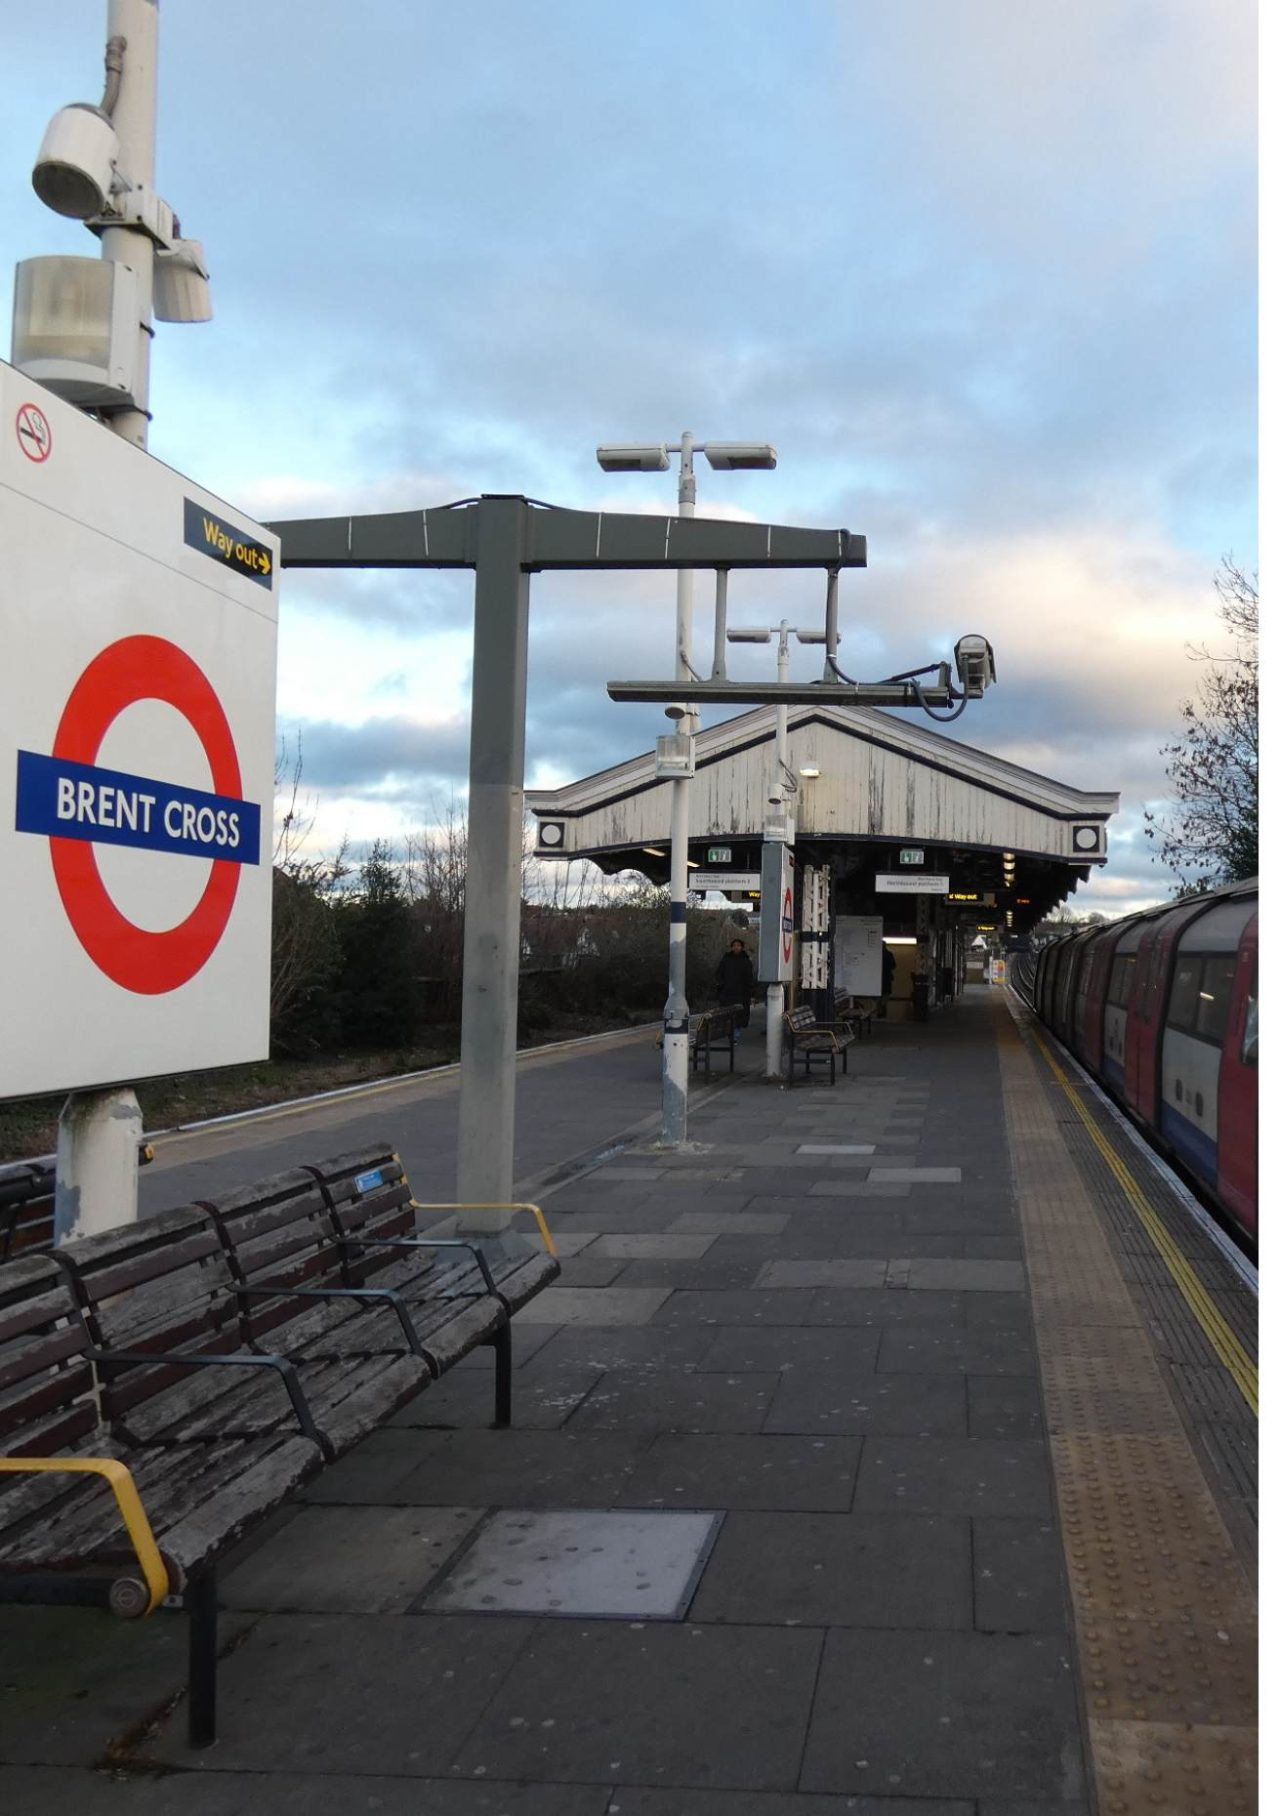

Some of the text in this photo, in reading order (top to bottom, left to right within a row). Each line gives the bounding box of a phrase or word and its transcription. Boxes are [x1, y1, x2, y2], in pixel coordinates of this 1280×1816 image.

[203, 517, 258, 569] Way out
[57, 777, 240, 848] BRENT CROSS
